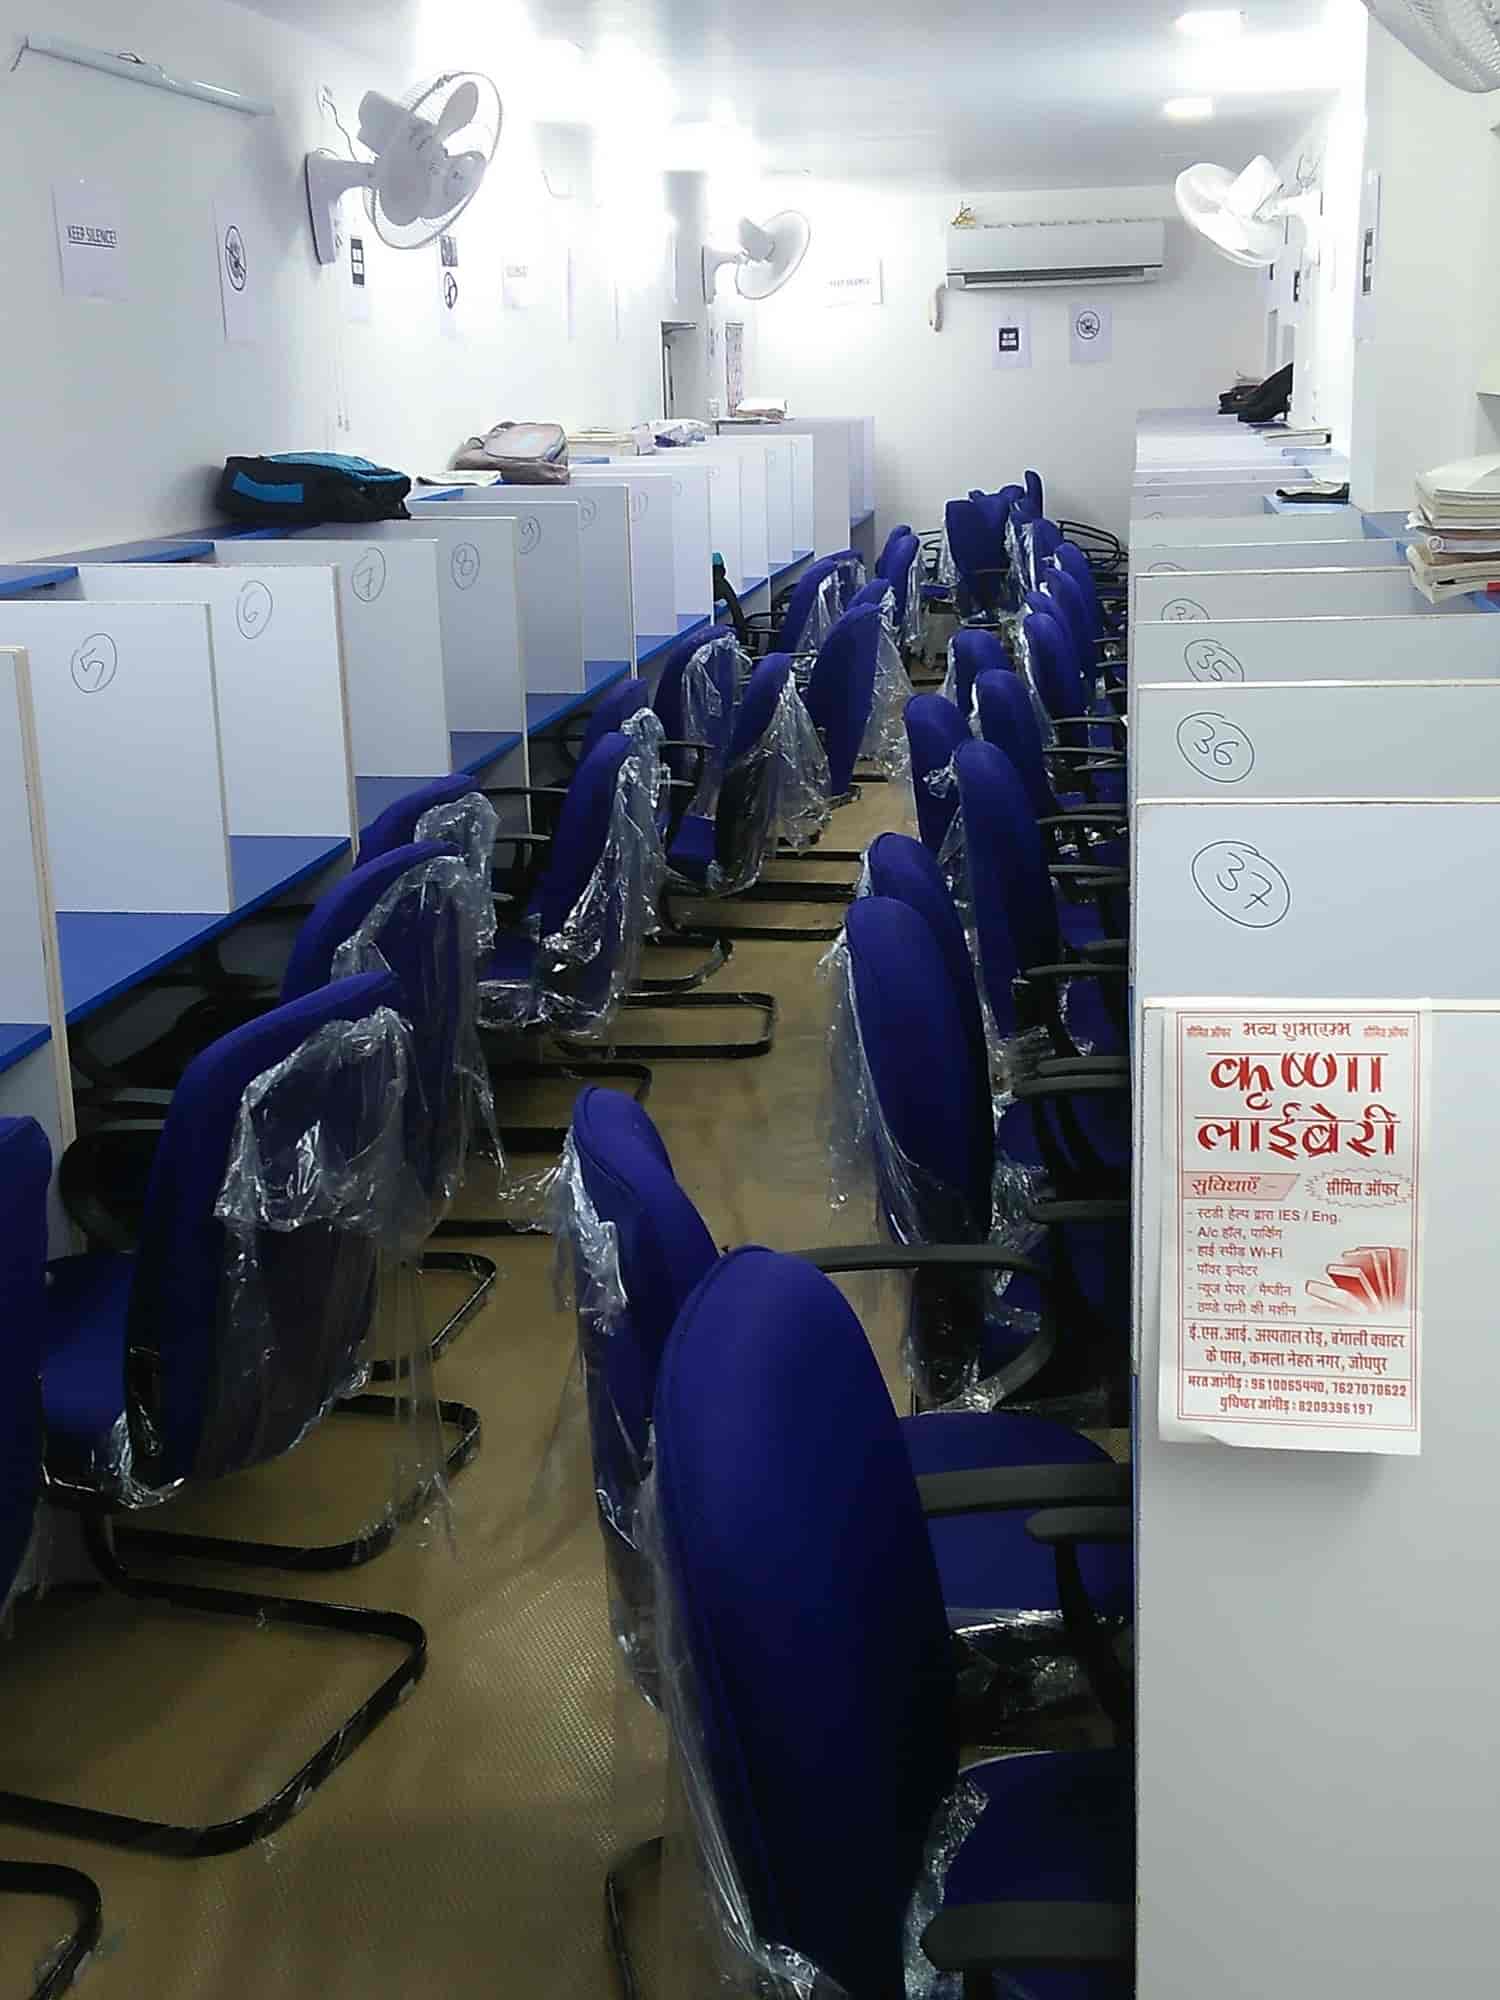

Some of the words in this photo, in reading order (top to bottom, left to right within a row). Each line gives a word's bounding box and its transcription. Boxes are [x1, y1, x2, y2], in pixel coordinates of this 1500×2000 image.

[1242, 1022, 1276, 1037] भव्य
[1206, 1052, 1389, 1111] कृष्णा
[1194, 1102, 1401, 1160] लाईब्रेरी
[1327, 1178, 1361, 1196] सीमित
[1365, 1178, 1400, 1198] ऑफर
[1280, 1209, 1300, 1221] IES
[1312, 1210, 1342, 1224] Eng.
[1198, 1226, 1218, 1238] A/c
[1250, 1246, 1282, 1258] Wi-Fi
[1224, 1280, 1247, 1295] पेपर
[1224, 1300, 1246, 1313] पानी
[1250, 1300, 1264, 1313] की
[1255, 1328, 1302, 1345] अस्पताल
[1331, 1328, 1368, 1347] बंगाली
[1205, 1345, 1217, 1362] के
[1249, 1351, 1285, 1367] कमला
[1347, 1352, 1388, 1375] जोधपुर
